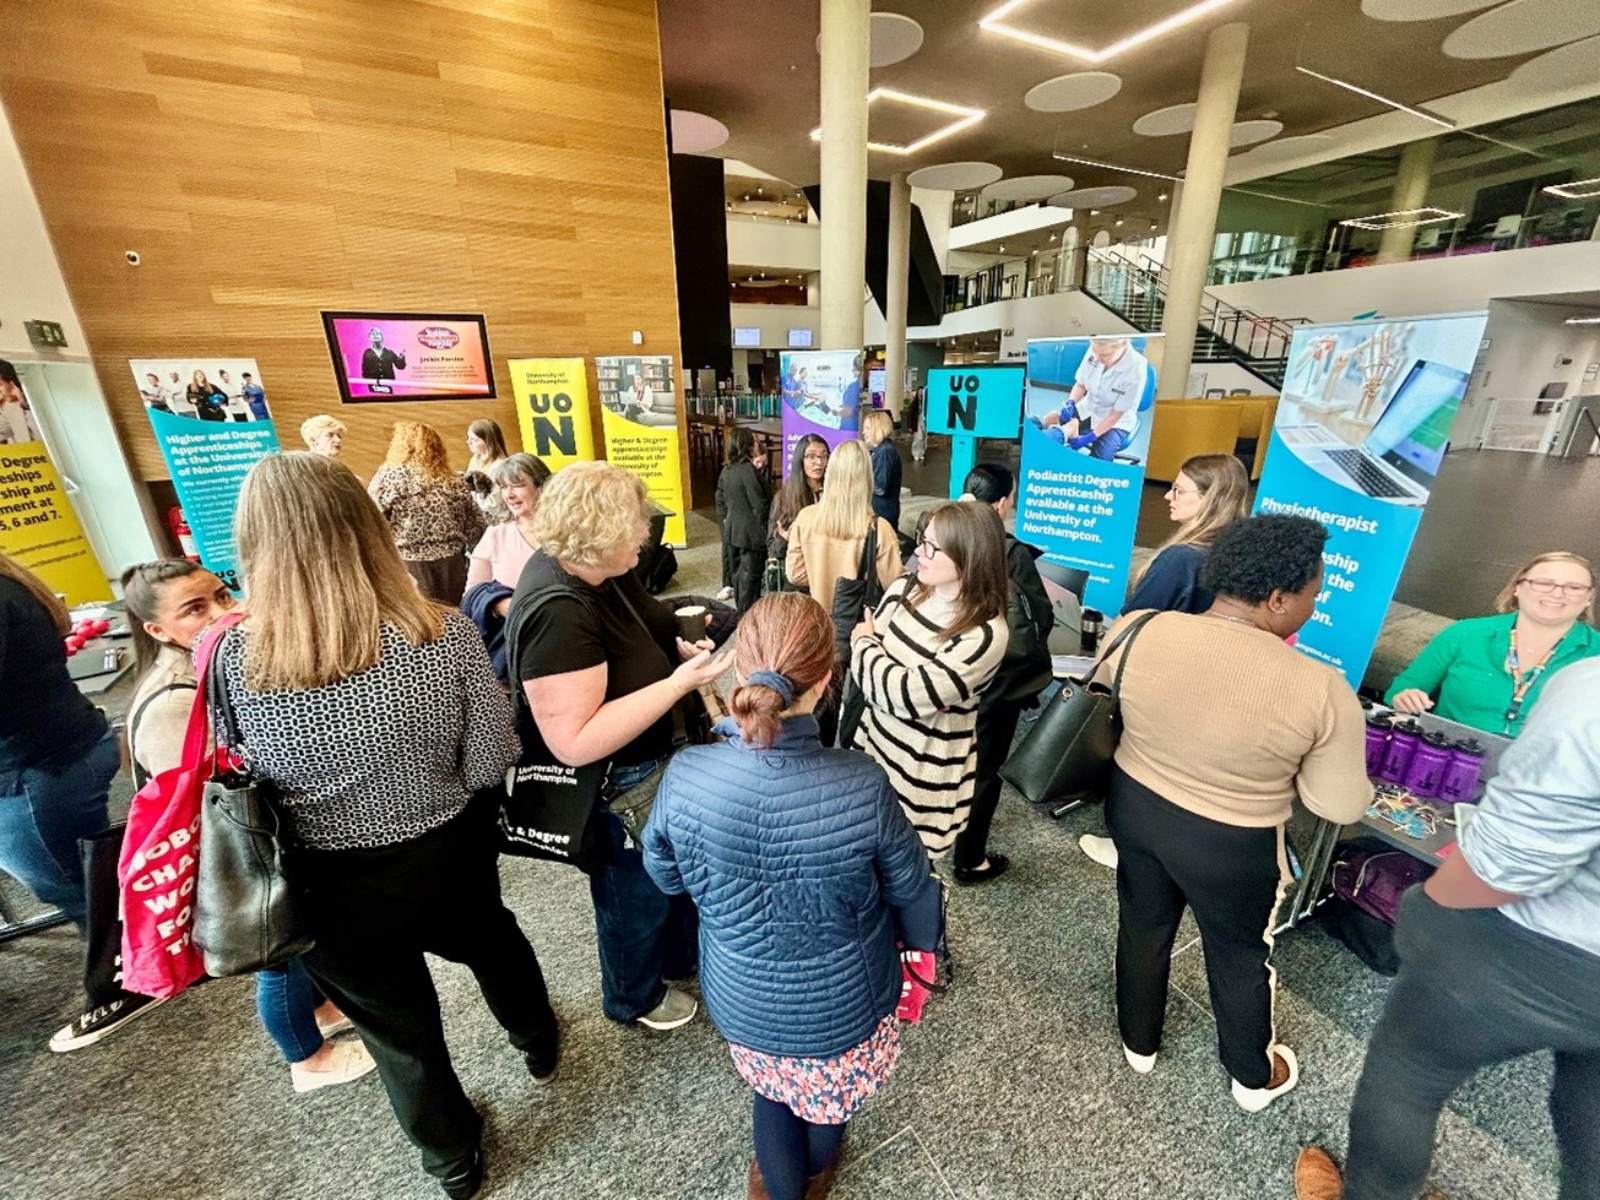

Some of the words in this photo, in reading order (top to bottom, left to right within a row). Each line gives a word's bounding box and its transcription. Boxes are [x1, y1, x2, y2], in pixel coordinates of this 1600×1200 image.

[949, 374, 980, 393] UO
[165, 434, 206, 446] Higher
[207, 431, 231, 441] and
[231, 430, 271, 441] Degree
[170, 441, 263, 457] Apprenticeships
[2, 455, 48, 469] Degree
[174, 457, 188, 466] at
[189, 455, 210, 465] the
[177, 466, 191, 476] of
[191, 461, 256, 476] Northamp
[33, 481, 57, 494] and
[1027, 470, 1084, 485] Podiatrist
[1085, 474, 1131, 489] Degree
[39, 497, 54, 508] at
[1026, 483, 1115, 504] Apprenticeship
[1025, 497, 1076, 511] available
[1076, 503, 1091, 514] at
[1091, 503, 1114, 517] the
[1260, 497, 1379, 535] Physiotherapist
[12, 517, 21, 528] 6
[23, 511, 49, 526] and
[50, 509, 63, 520] 7.
[1024, 509, 1082, 529] University
[1082, 517, 1097, 528] of
[1022, 522, 1103, 544] Northampton.
[1326, 573, 1355, 593] the
[519, 764, 564, 776] University
[565, 767, 576, 776] of
[516, 773, 578, 786] Northampton
[528, 827, 571, 845] Degree
